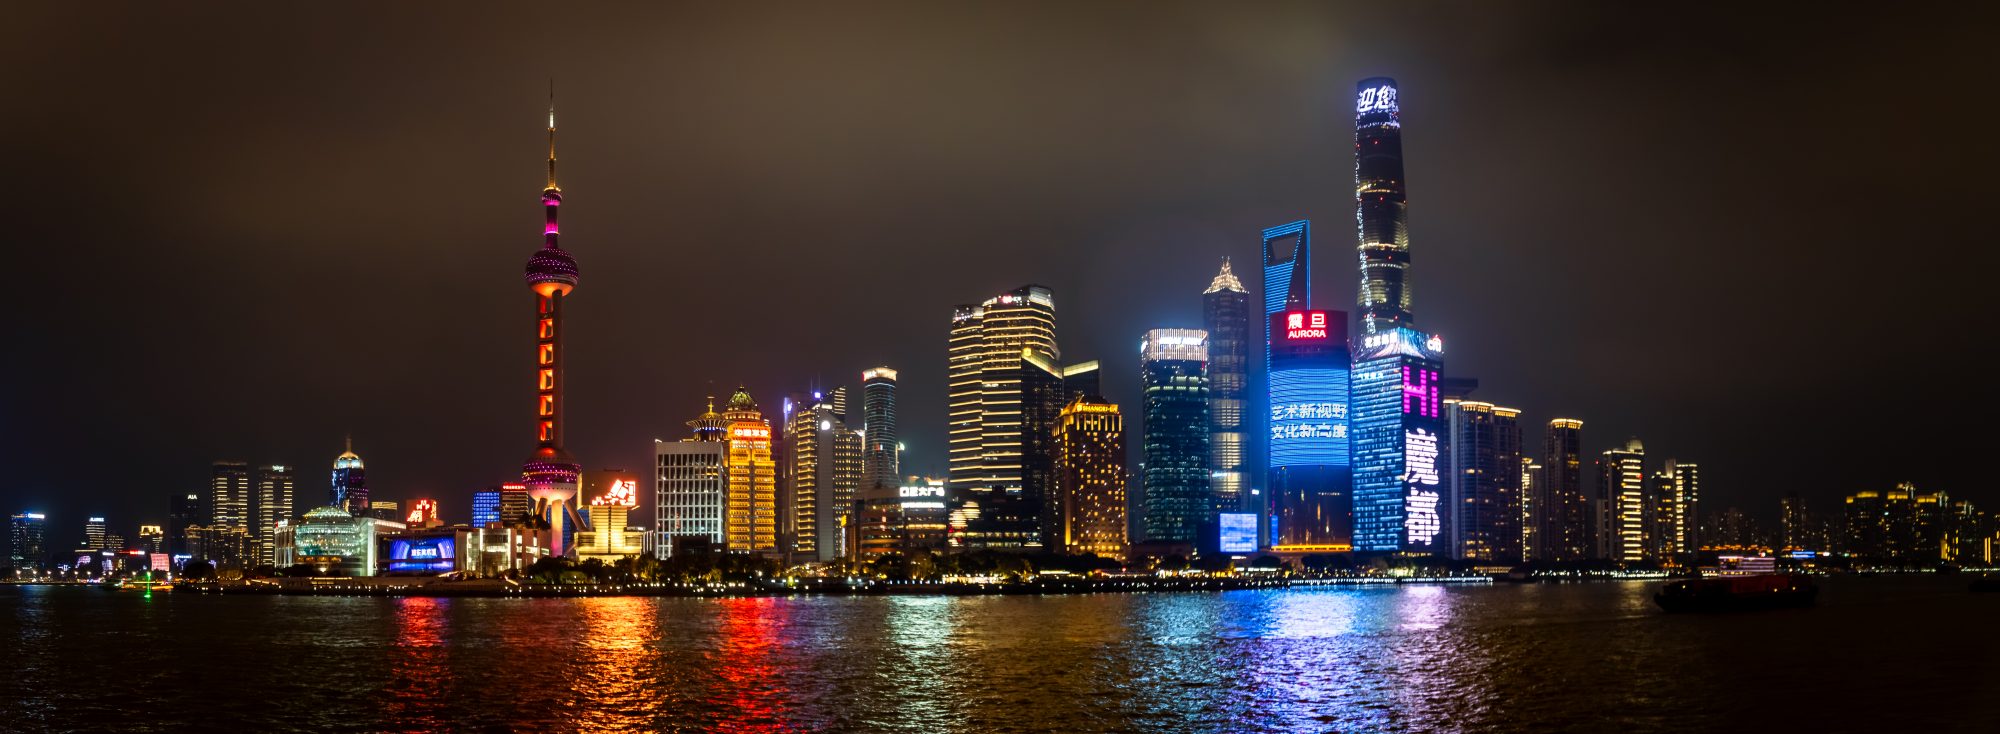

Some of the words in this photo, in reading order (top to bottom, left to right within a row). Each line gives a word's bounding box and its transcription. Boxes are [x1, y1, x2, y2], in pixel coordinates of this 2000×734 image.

[1357, 85, 1398, 112] 迎您
[1288, 313, 1326, 329] 震旦
[1288, 329, 1326, 339] AURORA
[1403, 366, 1438, 418] Hi
[1271, 403, 1347, 420] 艺术新视野
[1271, 423, 1347, 440] 文化新高度
[1404, 427, 1440, 546] 魔都
